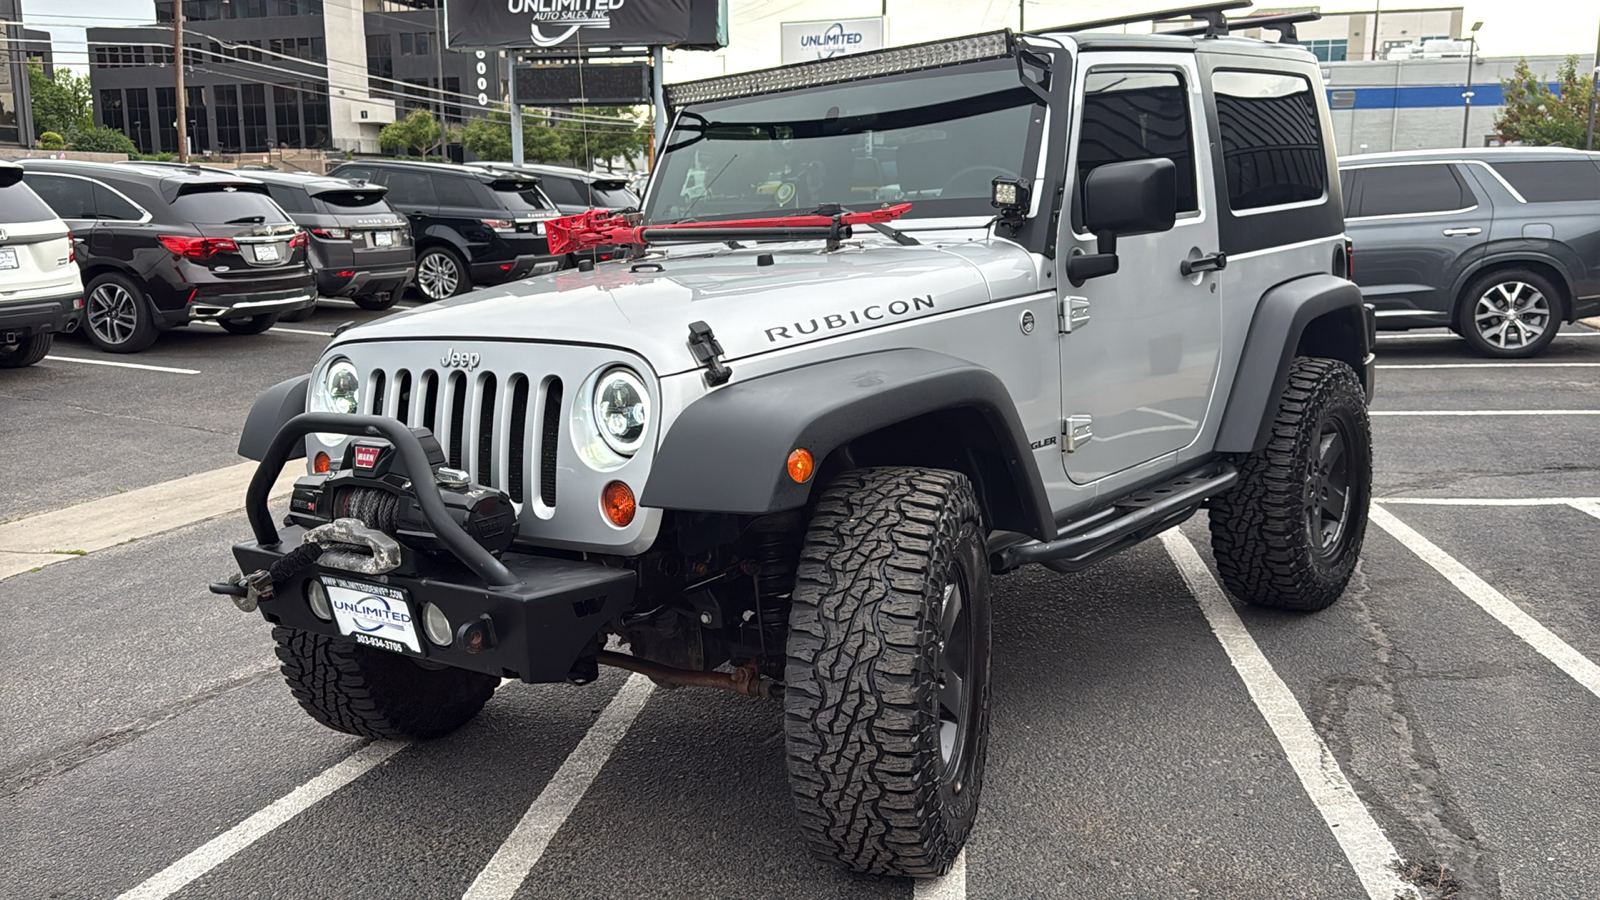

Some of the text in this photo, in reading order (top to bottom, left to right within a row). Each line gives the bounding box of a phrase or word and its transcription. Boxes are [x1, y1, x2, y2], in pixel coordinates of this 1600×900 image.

[508, 0, 625, 13] UNLIMITED
[533, 11, 560, 21] AUTO
[591, 9, 610, 19] INC.
[800, 32, 863, 47] UNLIMITED
[764, 294, 935, 343] RUBICON
[440, 347, 481, 372] Jeep
[1029, 436, 1057, 450] GLER
[357, 452, 375, 462] WARN
[333, 600, 412, 623] UNLIMITED
[355, 634, 403, 653] 303-934-3705
